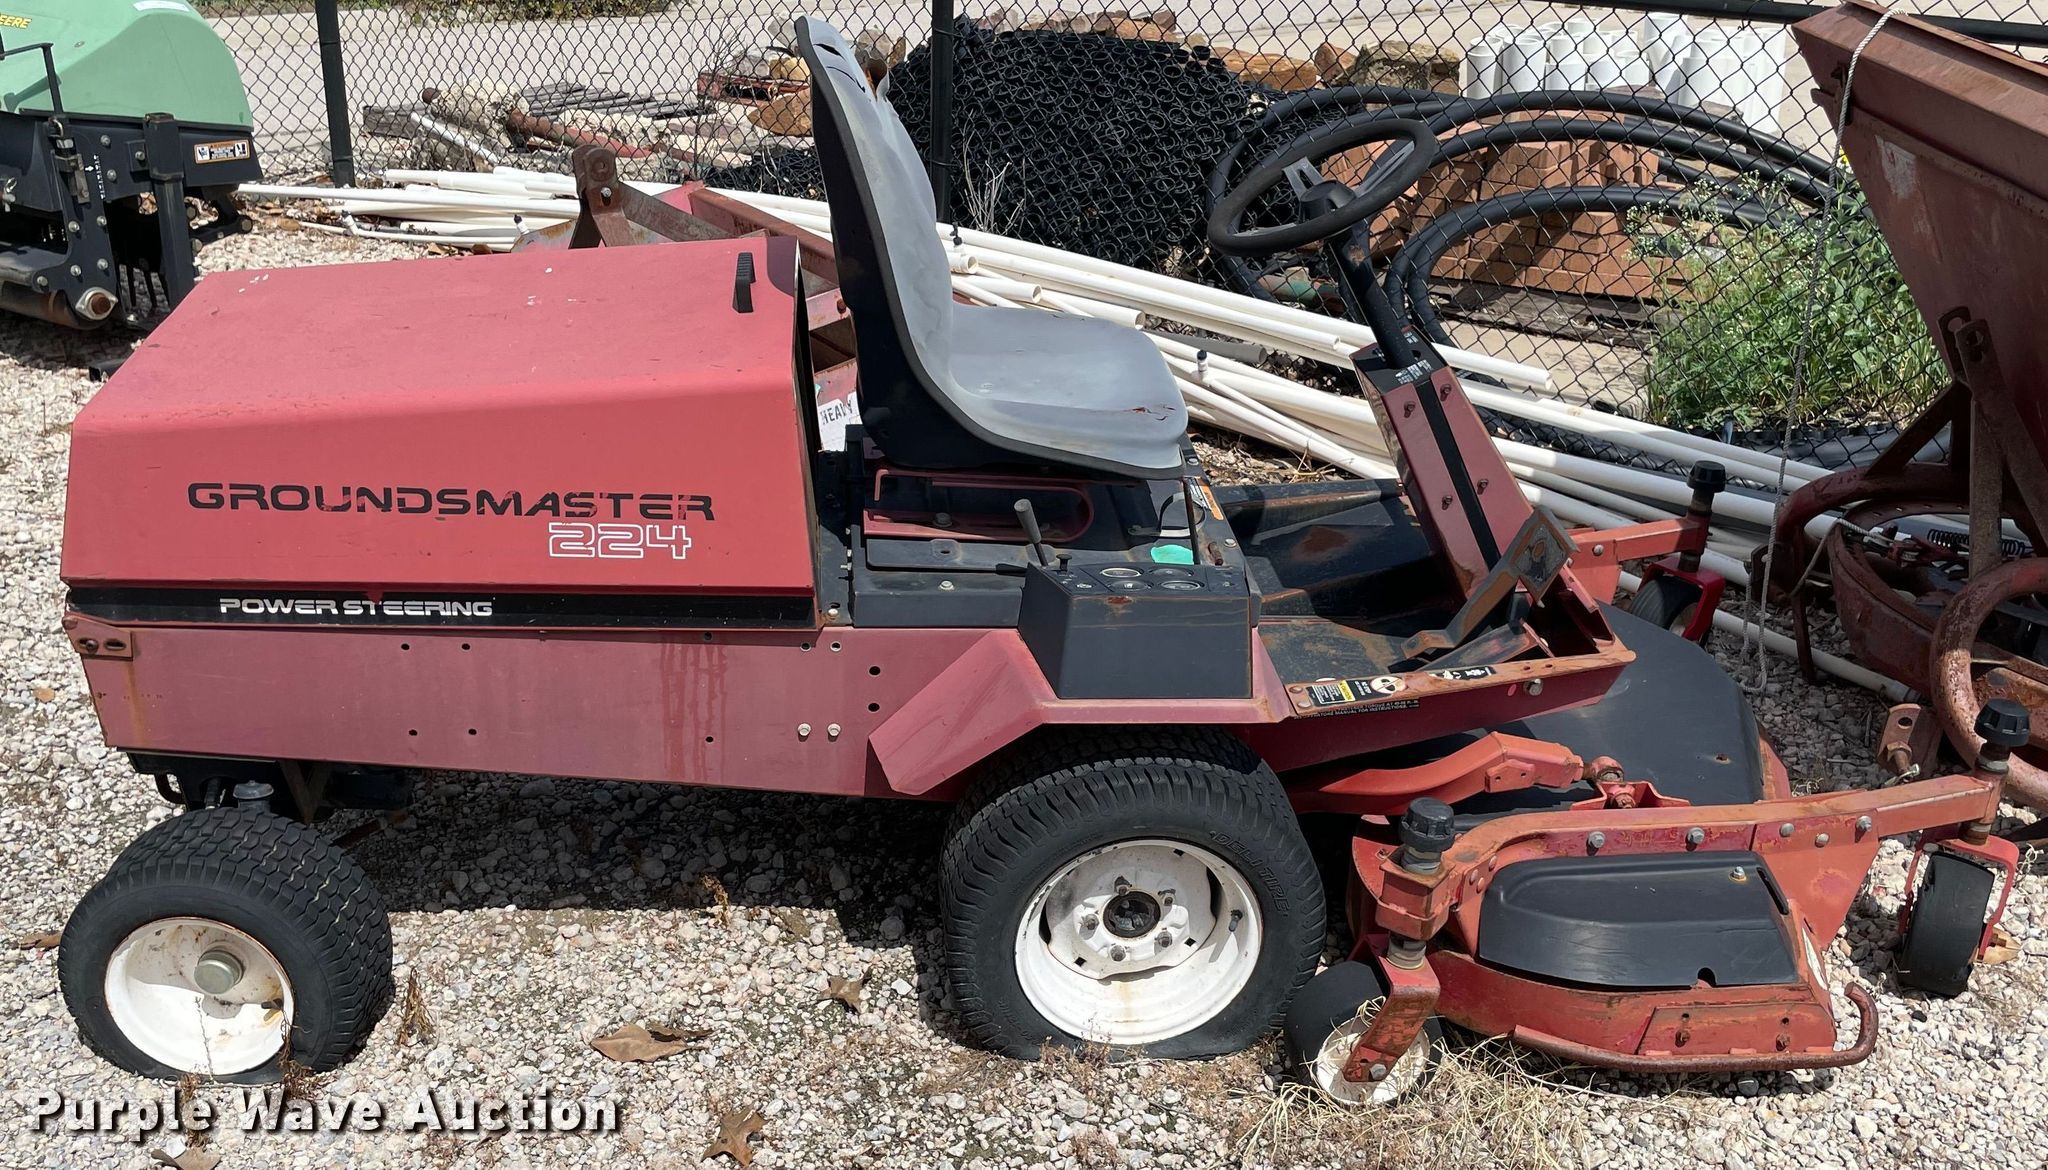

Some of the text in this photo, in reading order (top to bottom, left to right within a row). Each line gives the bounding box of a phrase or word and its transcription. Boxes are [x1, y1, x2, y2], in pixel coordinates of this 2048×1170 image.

[187, 482, 716, 522] GROUNDSMASTER
[548, 522, 692, 560] 224
[219, 597, 493, 617] POWER STEERING
